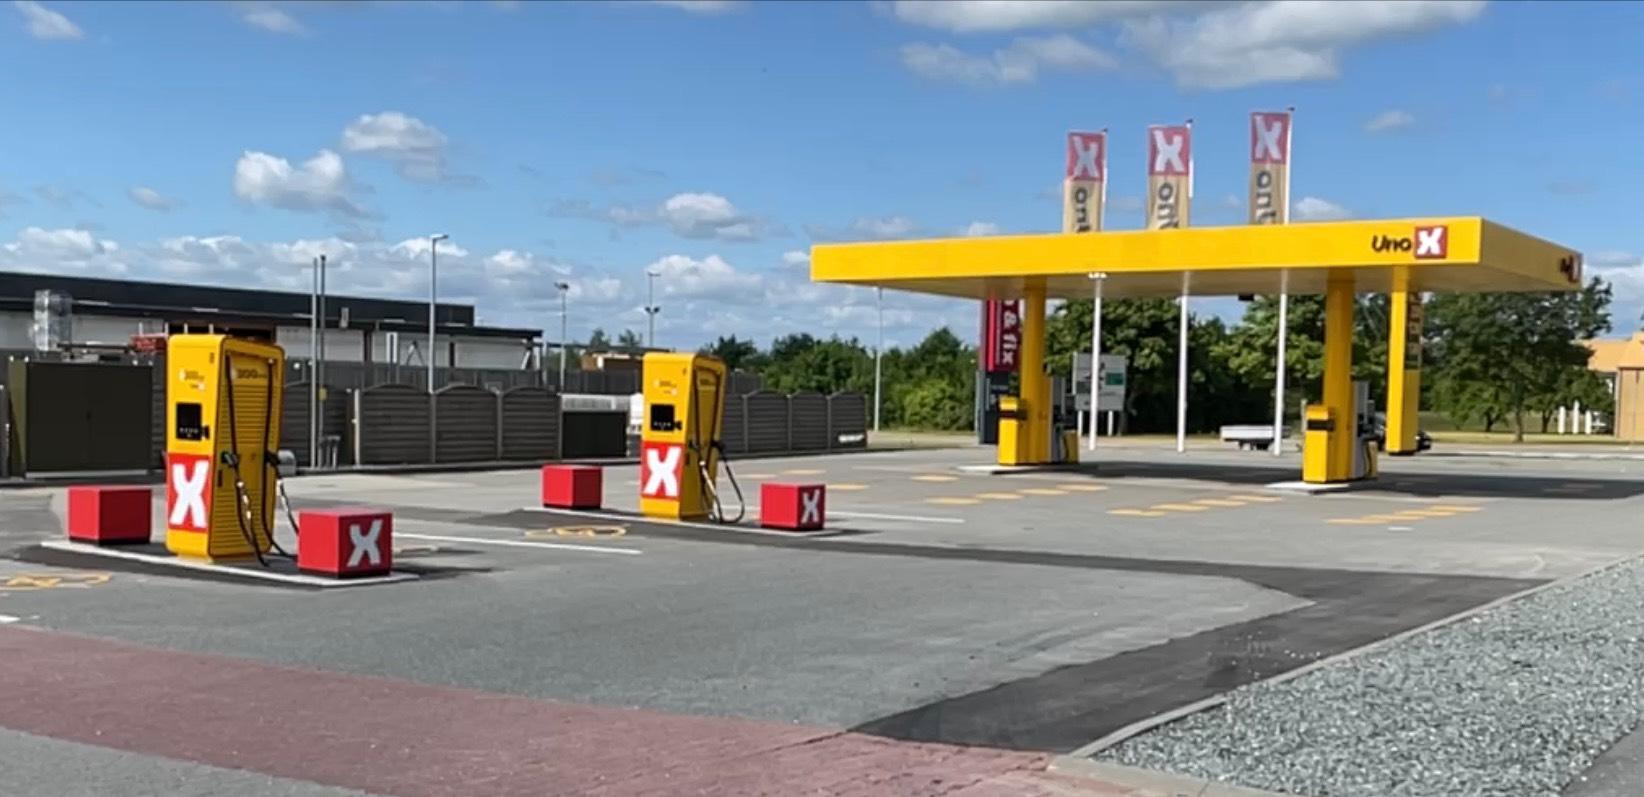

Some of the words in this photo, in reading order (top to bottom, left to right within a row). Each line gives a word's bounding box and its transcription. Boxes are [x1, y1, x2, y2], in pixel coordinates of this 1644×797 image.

[1371, 235, 1412, 252] Uno
[1416, 227, 1444, 255] X
[1003, 310, 1017, 329] &
[1003, 334, 1017, 365] fix
[642, 446, 682, 497] X
[168, 459, 209, 528] X
[801, 489, 820, 524] X
[347, 519, 383, 567] X
